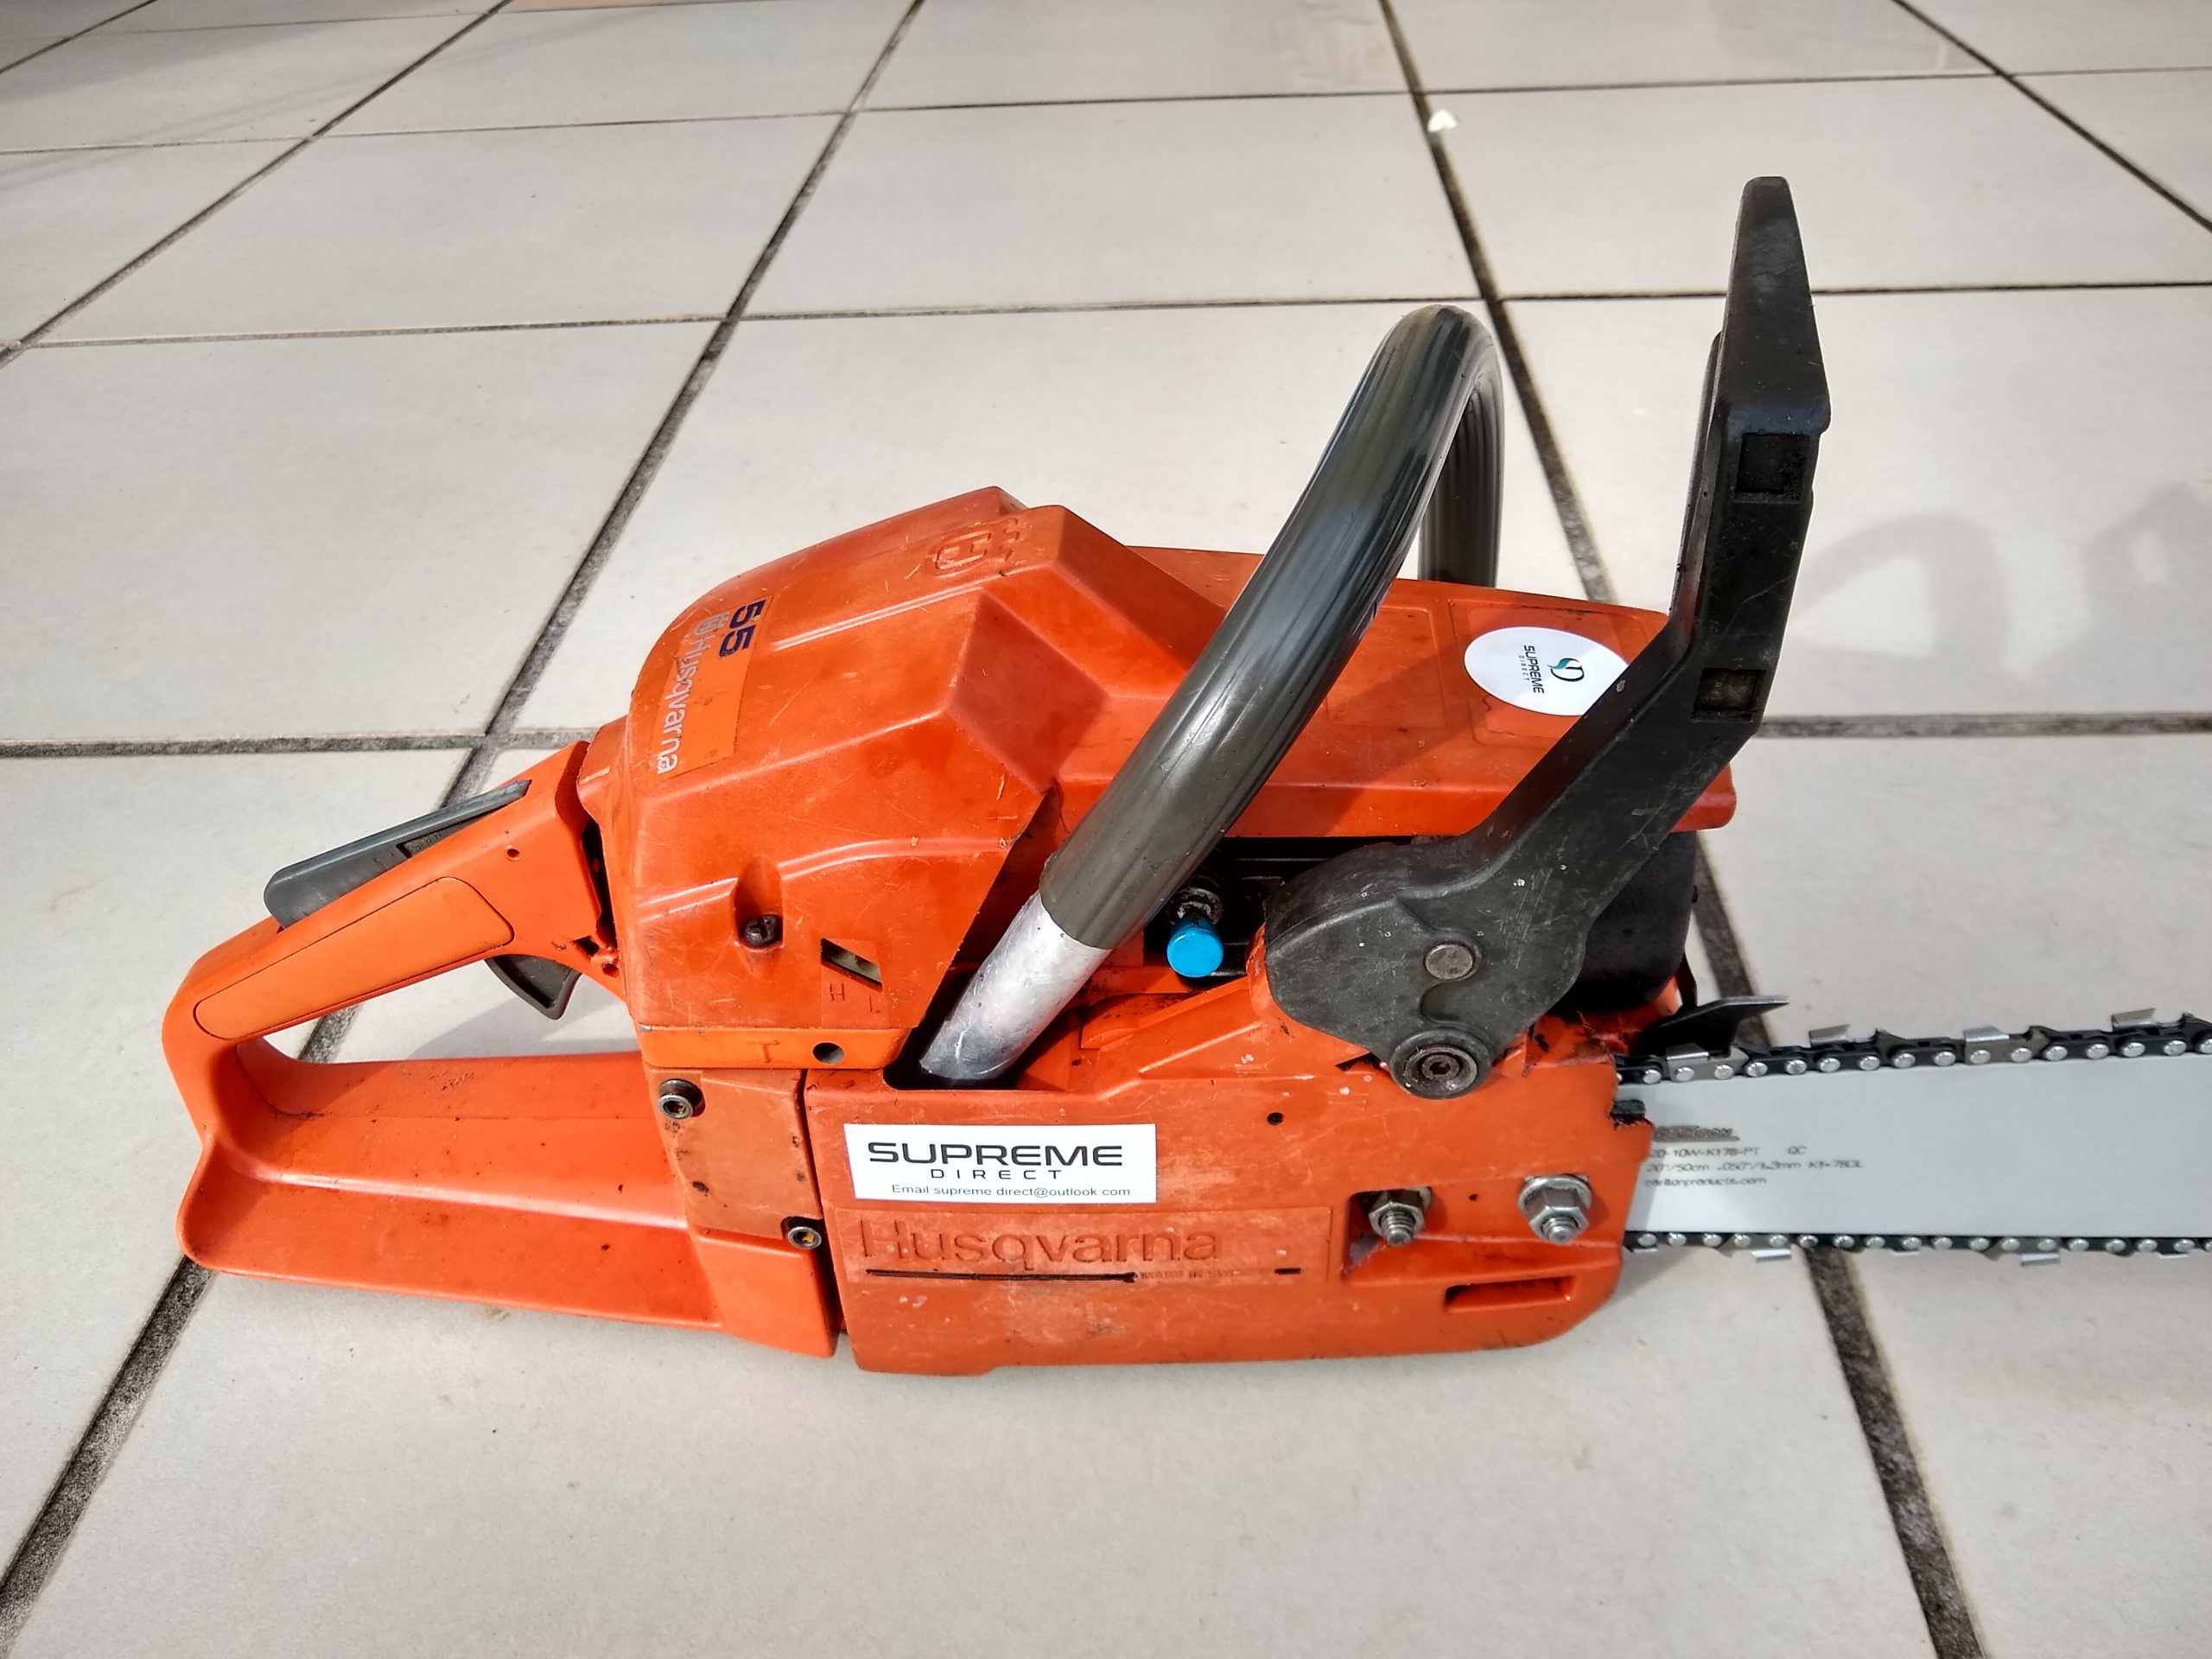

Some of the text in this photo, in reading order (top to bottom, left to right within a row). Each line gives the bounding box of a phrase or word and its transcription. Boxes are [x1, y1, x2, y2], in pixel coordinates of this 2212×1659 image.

[719, 599, 766, 658] 55
[1518, 655, 1529, 681] DIRECT
[1523, 645, 1544, 694] SUPREME
[657, 633, 711, 775] Husqvarna
[829, 982, 845, 1001] H
[868, 1141, 1123, 1166] SUPREME
[931, 1169, 1062, 1180] DIRECT
[892, 1185, 1131, 1198] Email supreme direct@outlookcom
[859, 1218, 1224, 1272] Husqvarna
